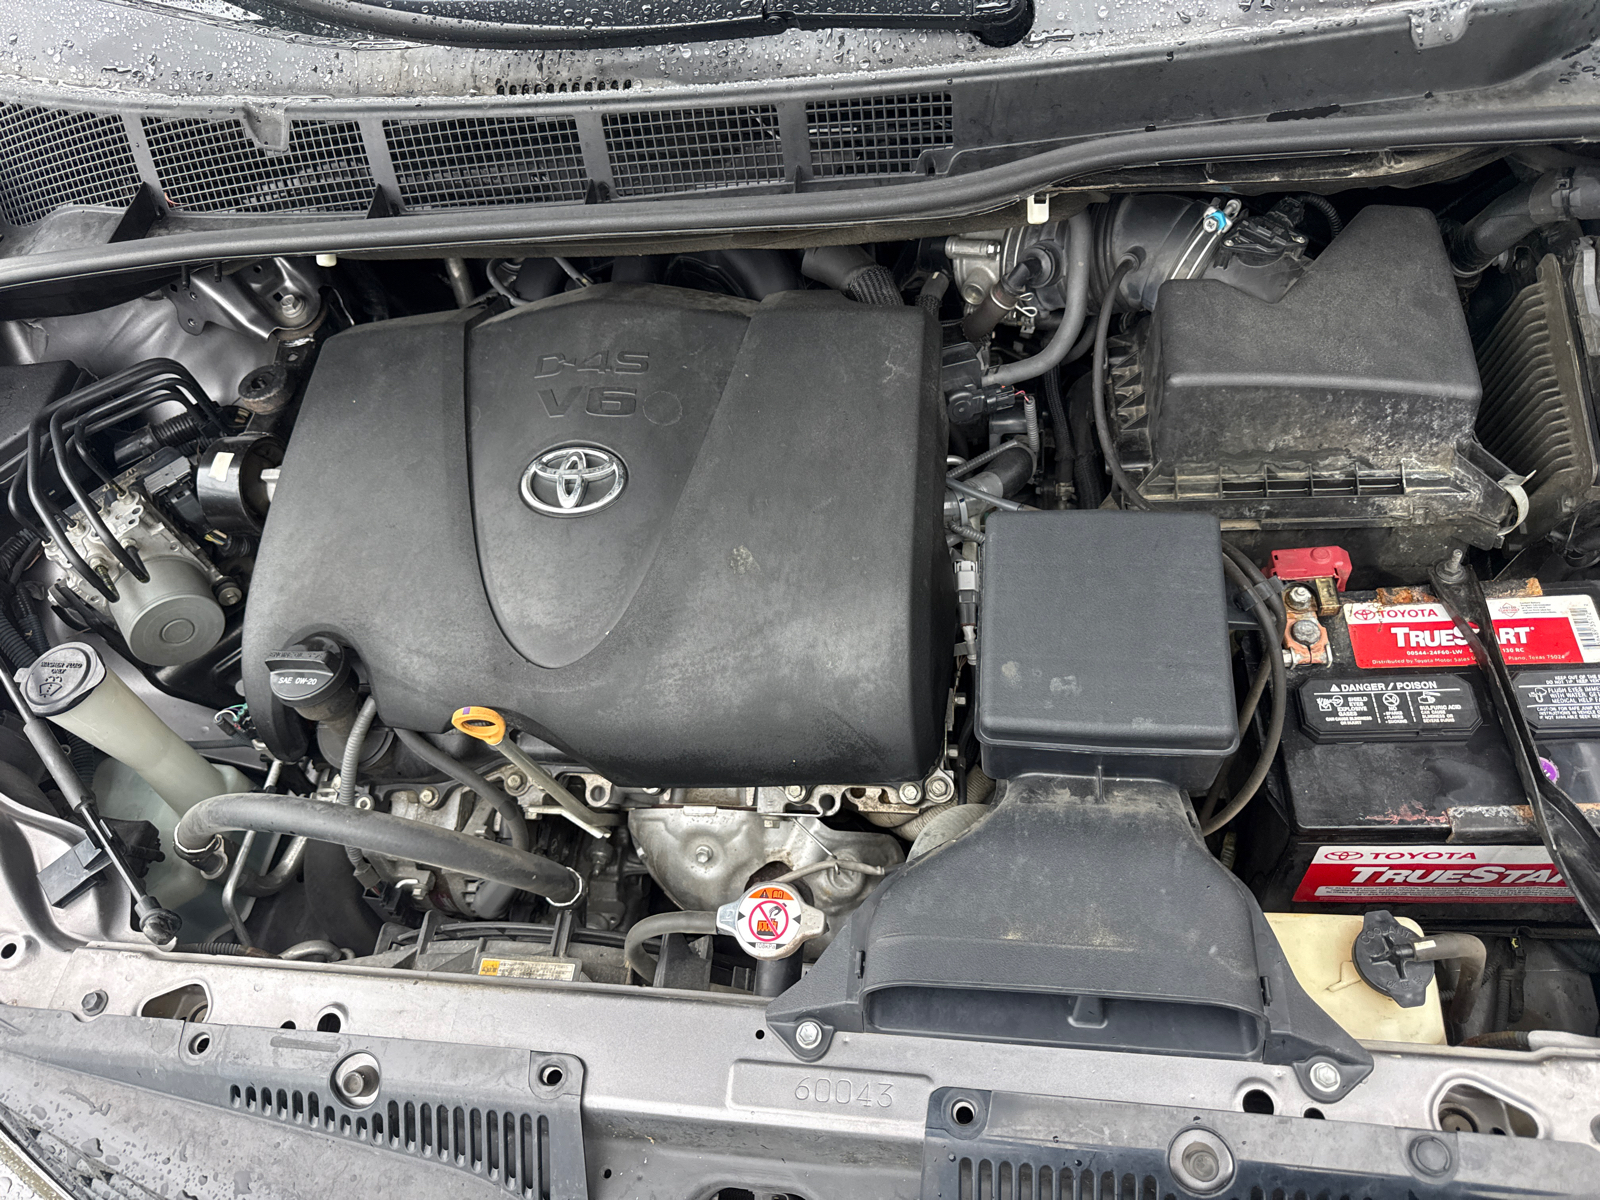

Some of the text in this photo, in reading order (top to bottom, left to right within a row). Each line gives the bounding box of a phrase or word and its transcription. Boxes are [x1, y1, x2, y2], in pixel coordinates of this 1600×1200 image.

[534, 350, 649, 379] D-4S
[537, 386, 637, 418] V6
[1379, 608, 1439, 619] TOYOTA
[278, 676, 318, 685] SAE 0W-20
[1340, 682, 1386, 692] DANGER
[1396, 680, 1438, 690] POISON
[1370, 852, 1477, 860] TOYOTA
[1350, 865, 1563, 884] TRUESTA
[794, 1076, 894, 1108] 60043
